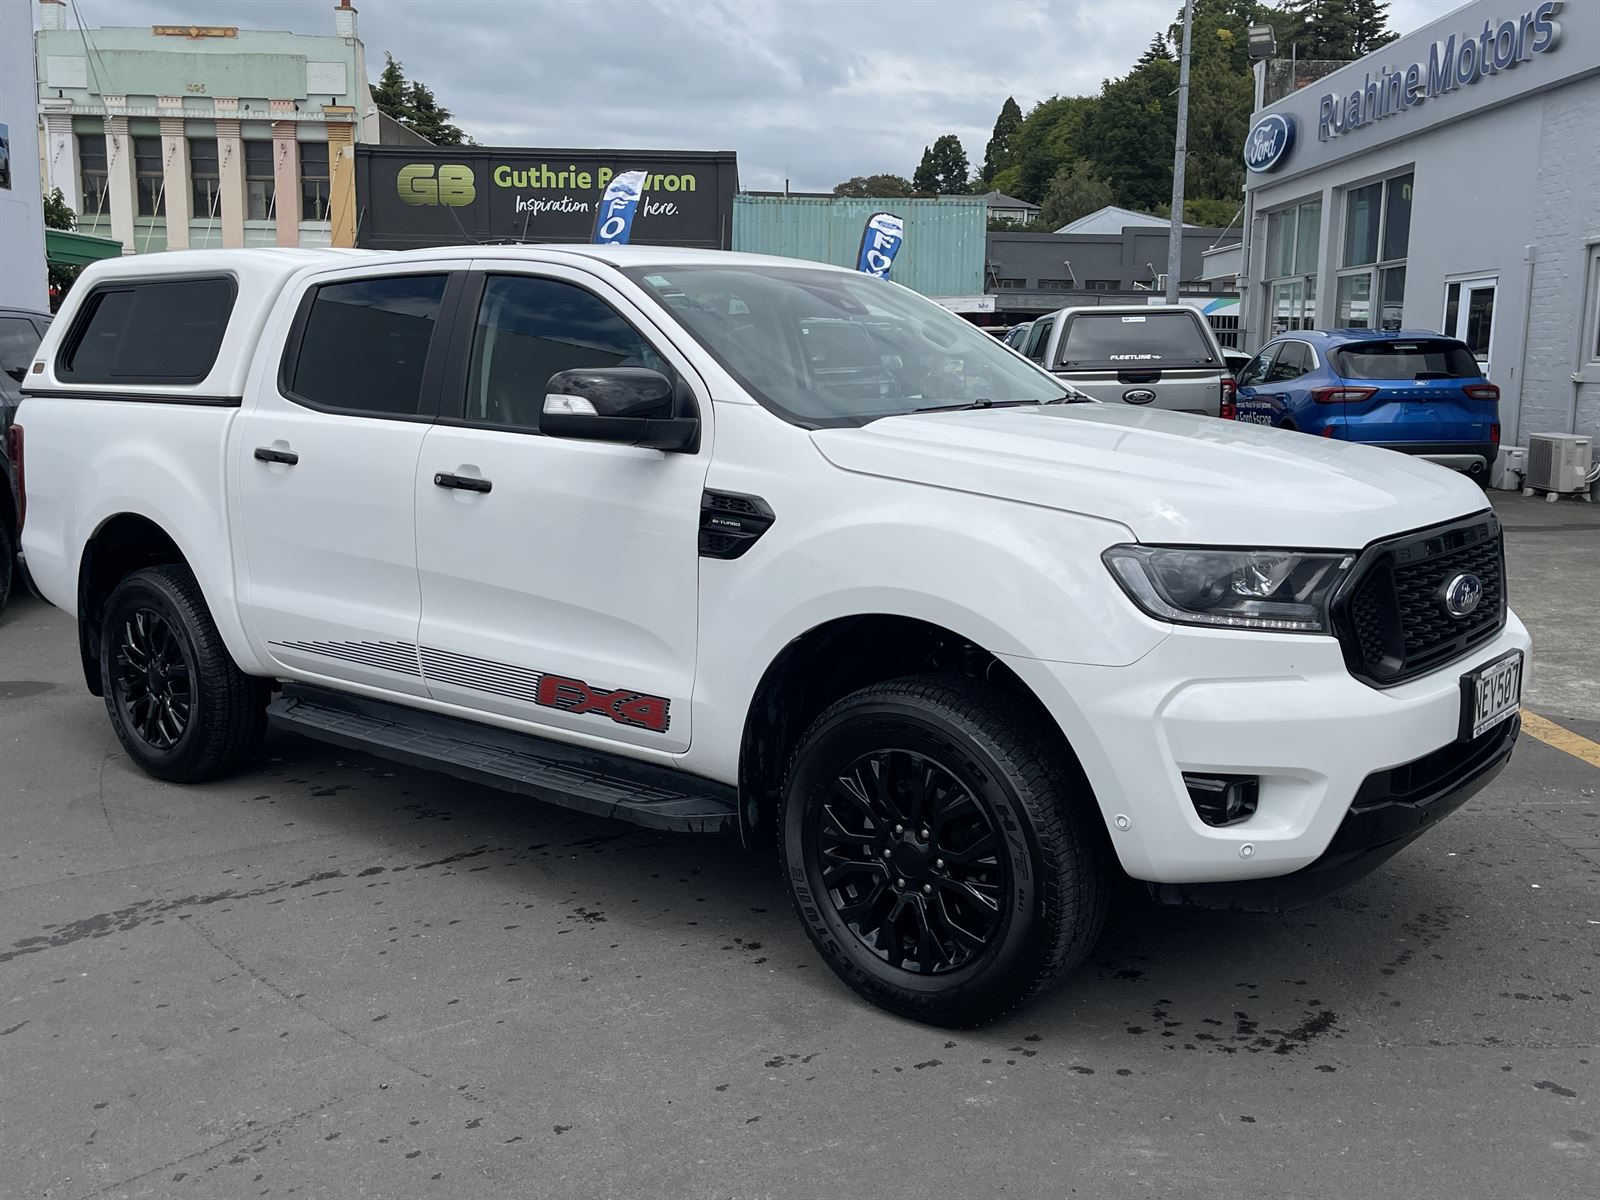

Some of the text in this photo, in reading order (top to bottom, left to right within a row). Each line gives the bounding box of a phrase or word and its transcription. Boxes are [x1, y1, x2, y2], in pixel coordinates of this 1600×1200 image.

[1318, 1, 1562, 141] Ruahine Motors
[1250, 124, 1279, 164] Ford
[397, 164, 476, 207] GB
[494, 164, 696, 191] Guthrie Bron
[516, 195, 589, 216] Inspiration
[643, 196, 679, 217] here.
[537, 675, 668, 731] FX4
